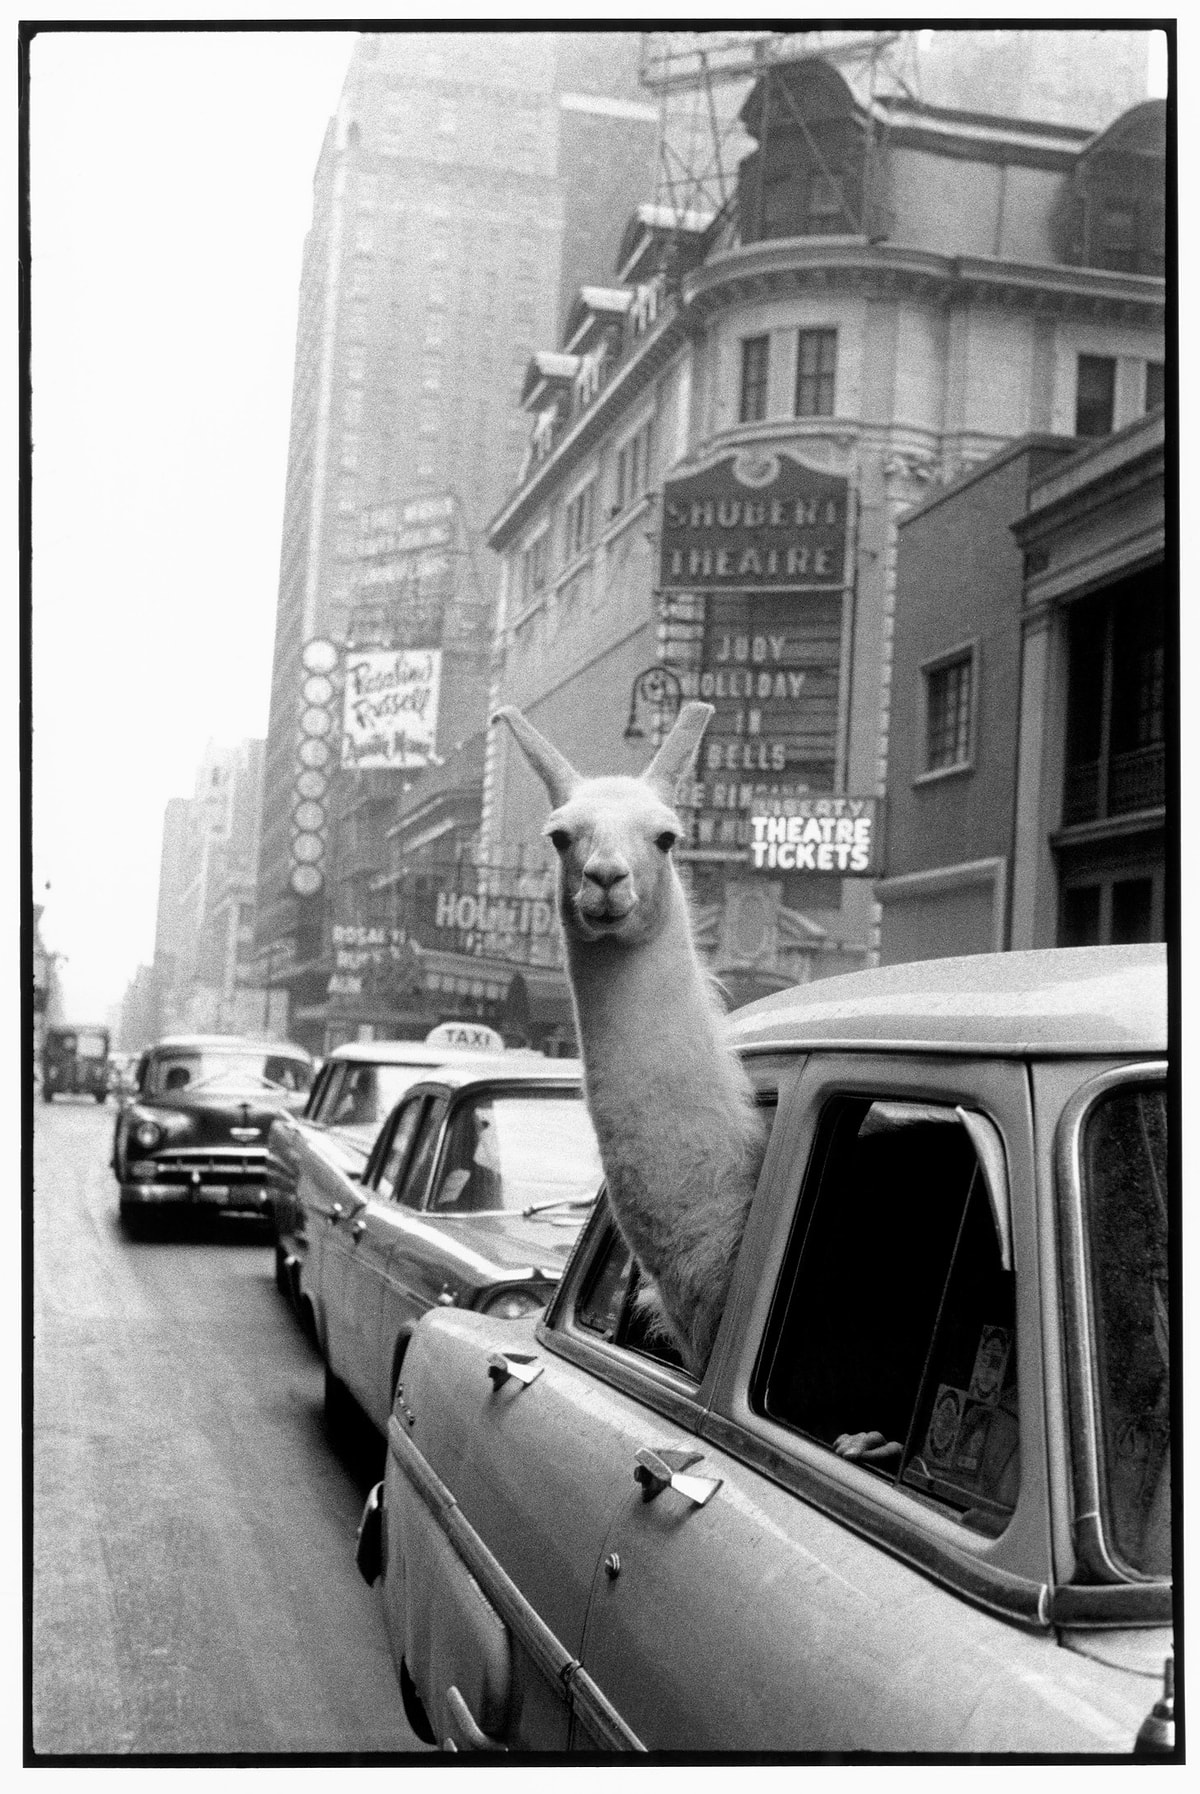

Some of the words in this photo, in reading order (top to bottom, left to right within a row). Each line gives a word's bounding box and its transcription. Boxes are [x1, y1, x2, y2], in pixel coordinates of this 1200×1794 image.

[669, 547, 834, 577] THEATRE
[715, 636, 786, 664] JUDY
[681, 672, 806, 698] HOLLIDAY
[707, 744, 786, 771] BELLS
[751, 816, 871, 844] THEATRE
[751, 841, 869, 871] TICKETS
[436, 892, 552, 934] HOLLID
[445, 1028, 491, 1046] TAXI
